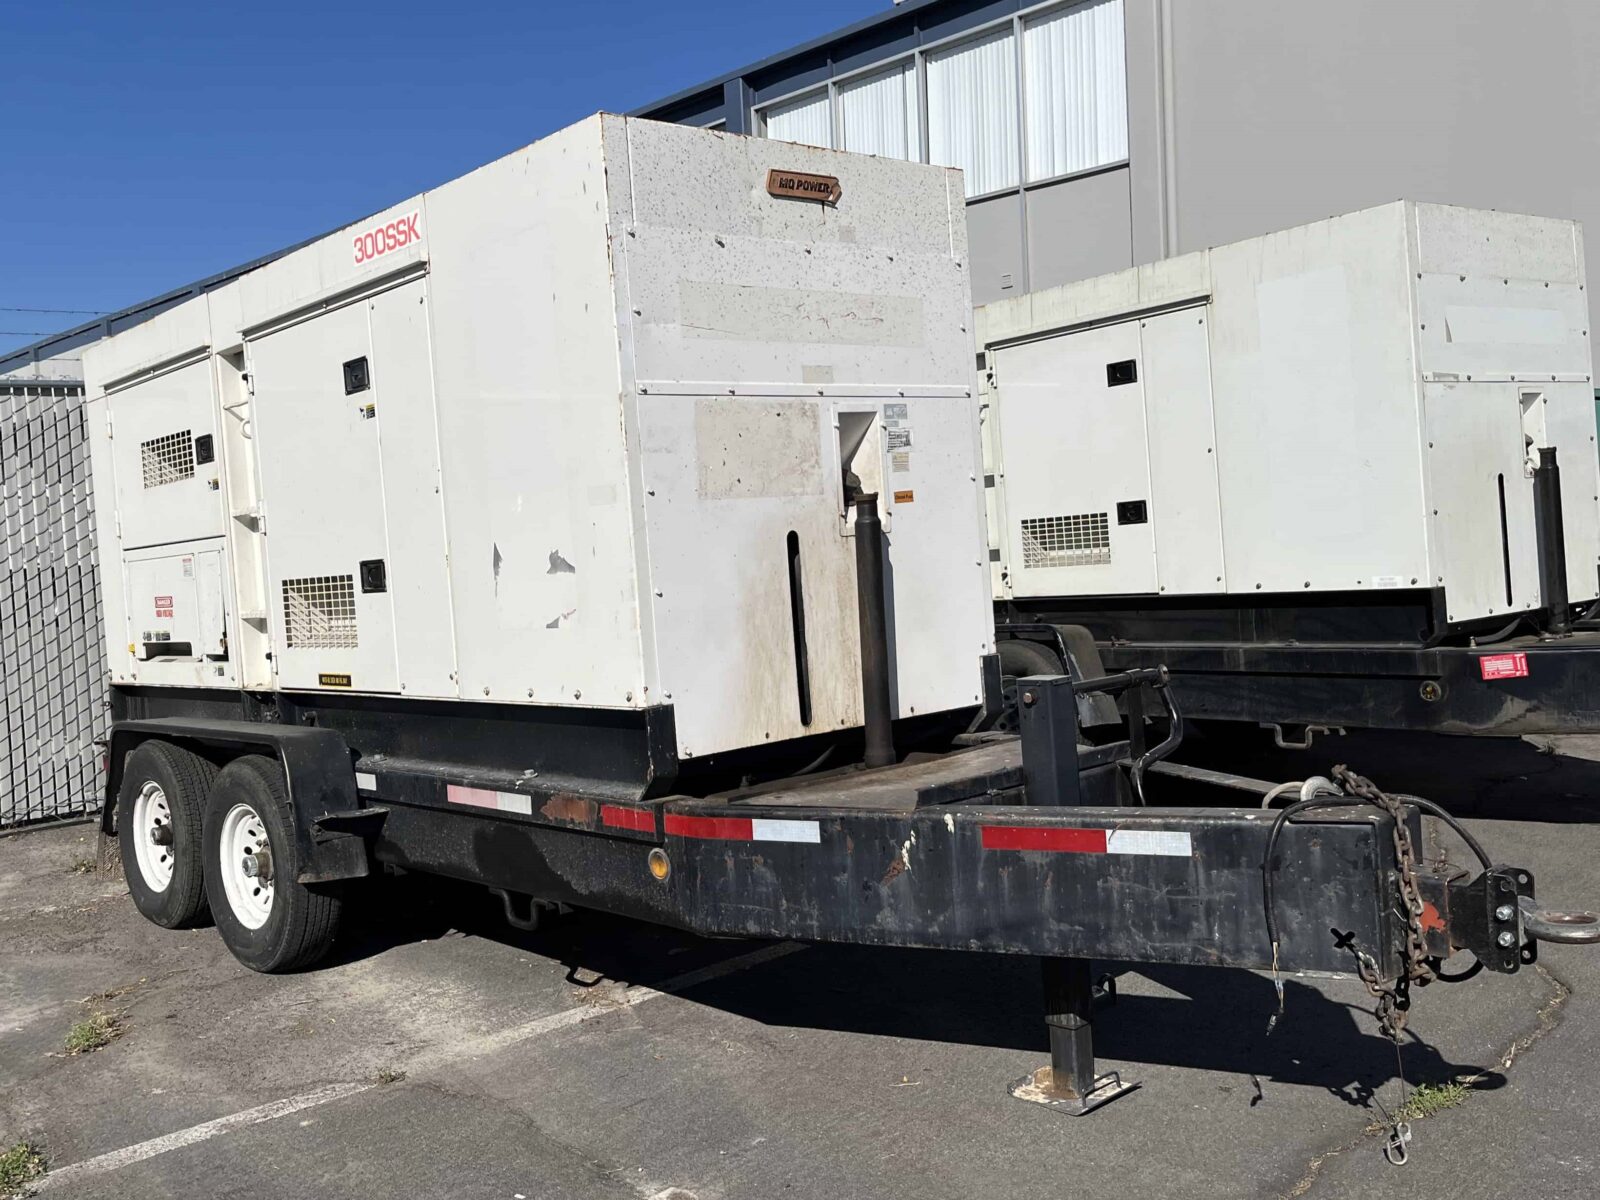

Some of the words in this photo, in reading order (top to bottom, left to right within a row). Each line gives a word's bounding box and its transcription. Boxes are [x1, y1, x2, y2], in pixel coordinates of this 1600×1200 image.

[778, 177, 795, 191] MQ
[796, 178, 831, 194] POWER
[353, 212, 421, 264] 300SSK
